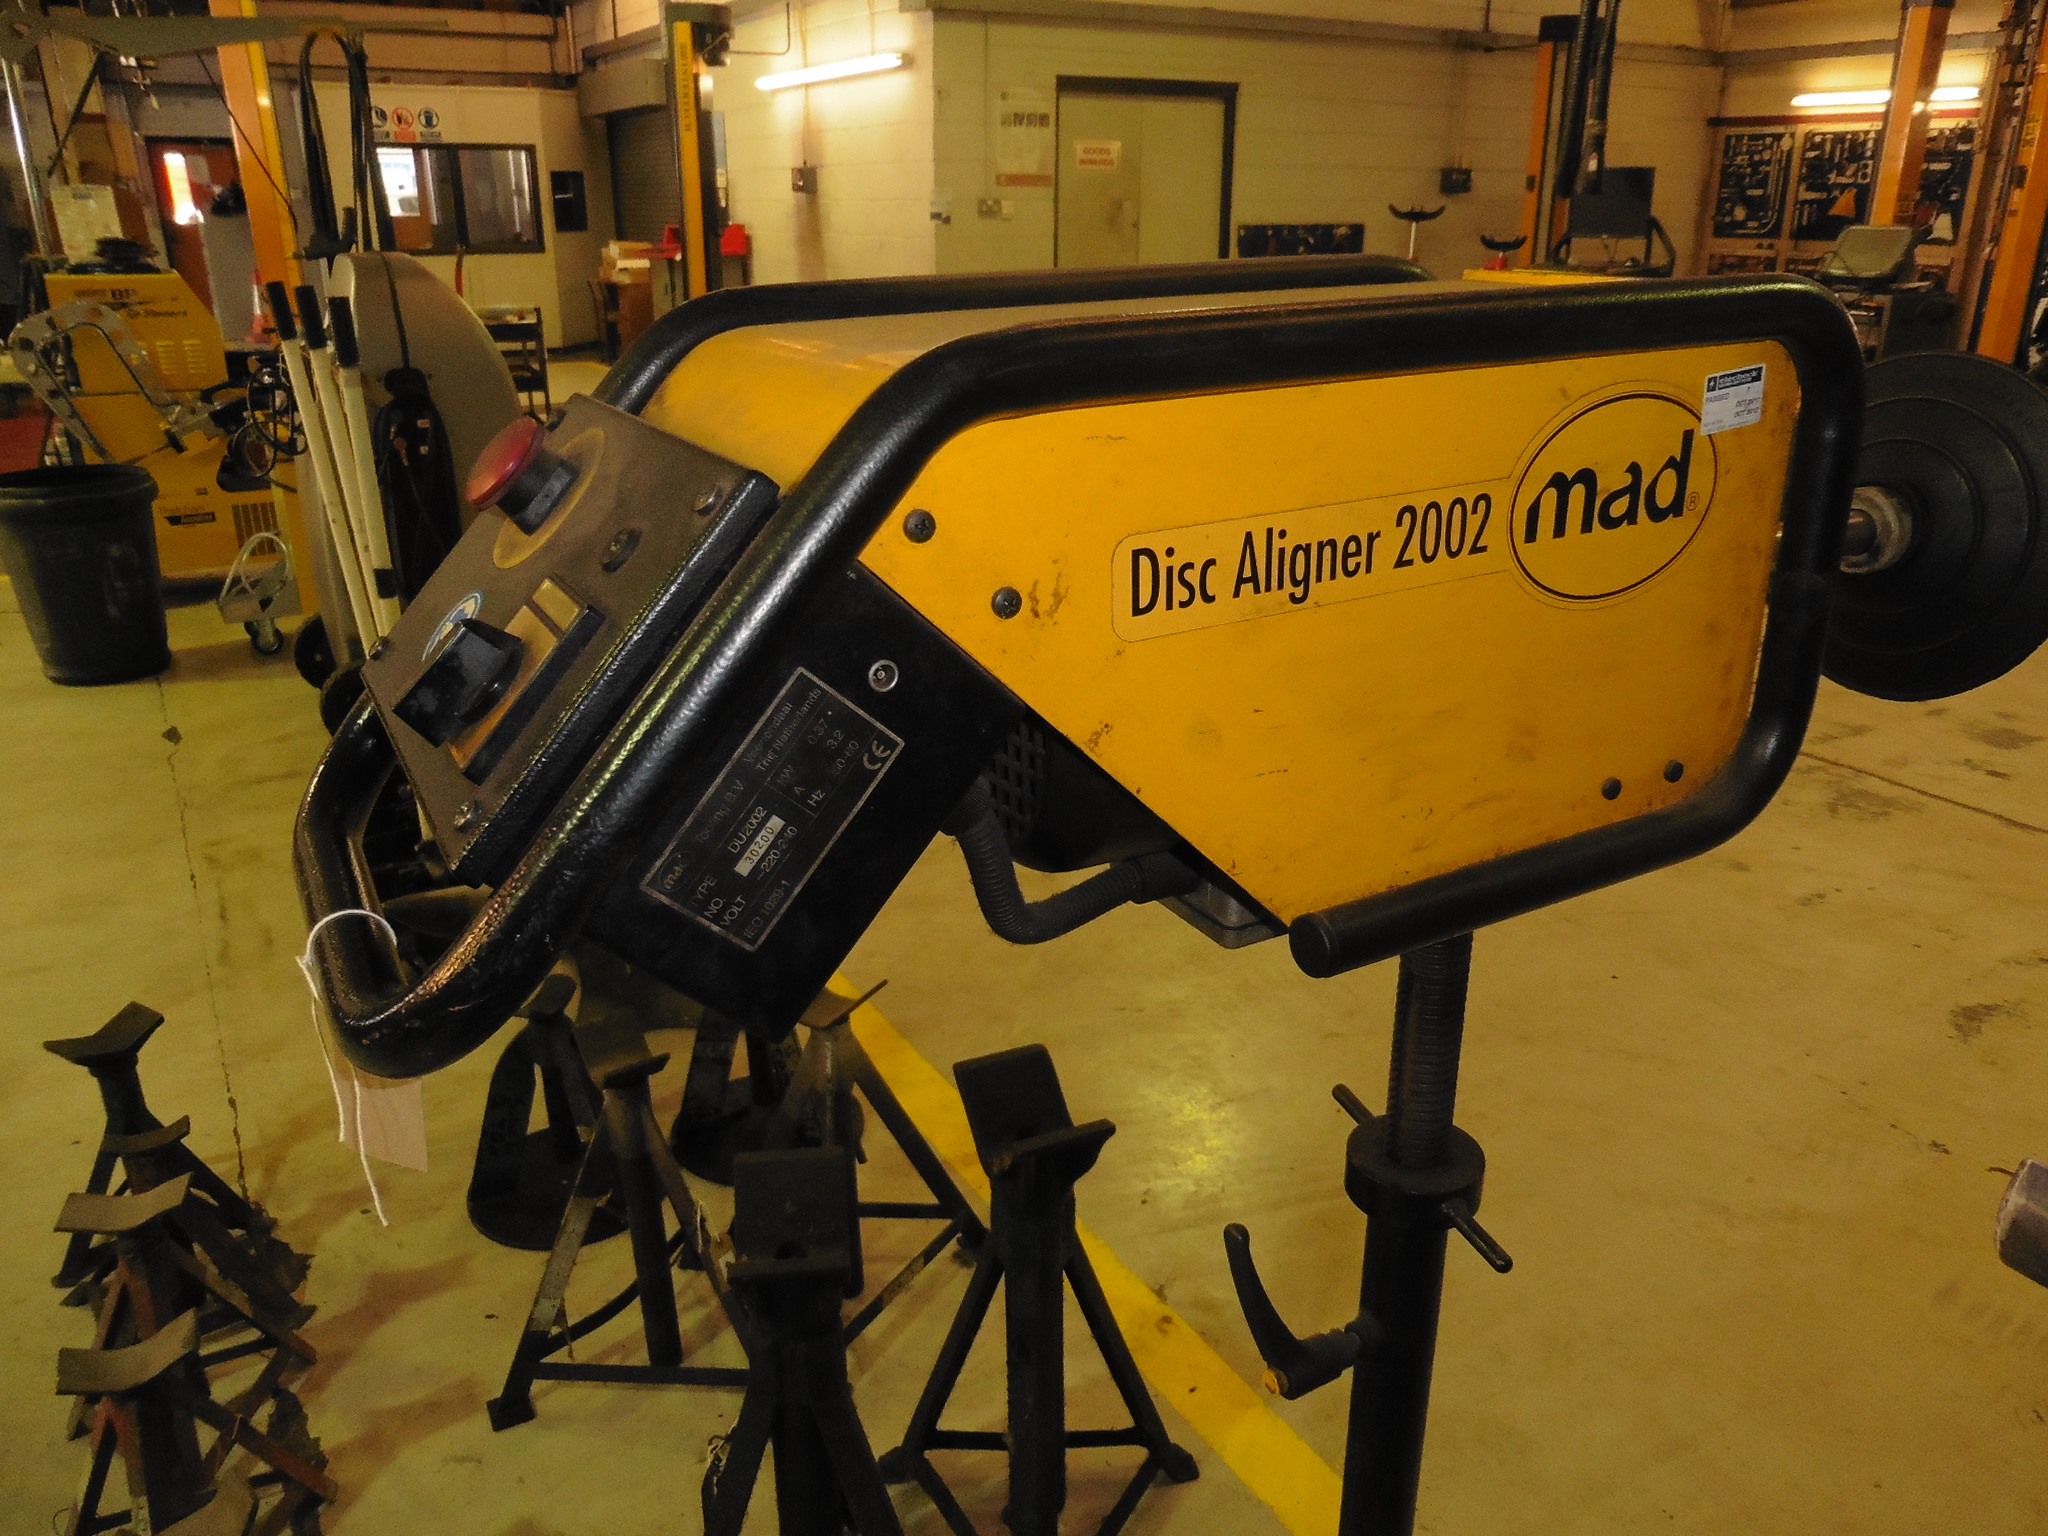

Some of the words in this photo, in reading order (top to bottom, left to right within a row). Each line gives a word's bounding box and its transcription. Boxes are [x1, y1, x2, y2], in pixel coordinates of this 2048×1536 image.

[1524, 428, 1694, 544] mad
[1131, 546, 1217, 617] Disc
[1232, 527, 1381, 605] Aligner
[1393, 493, 1492, 569] 2002
[790, 782, 807, 798] A
[805, 786, 827, 808] Hz
[725, 803, 769, 855] DU2002
[741, 824, 777, 866] 30200
[718, 893, 750, 928] VOLT
